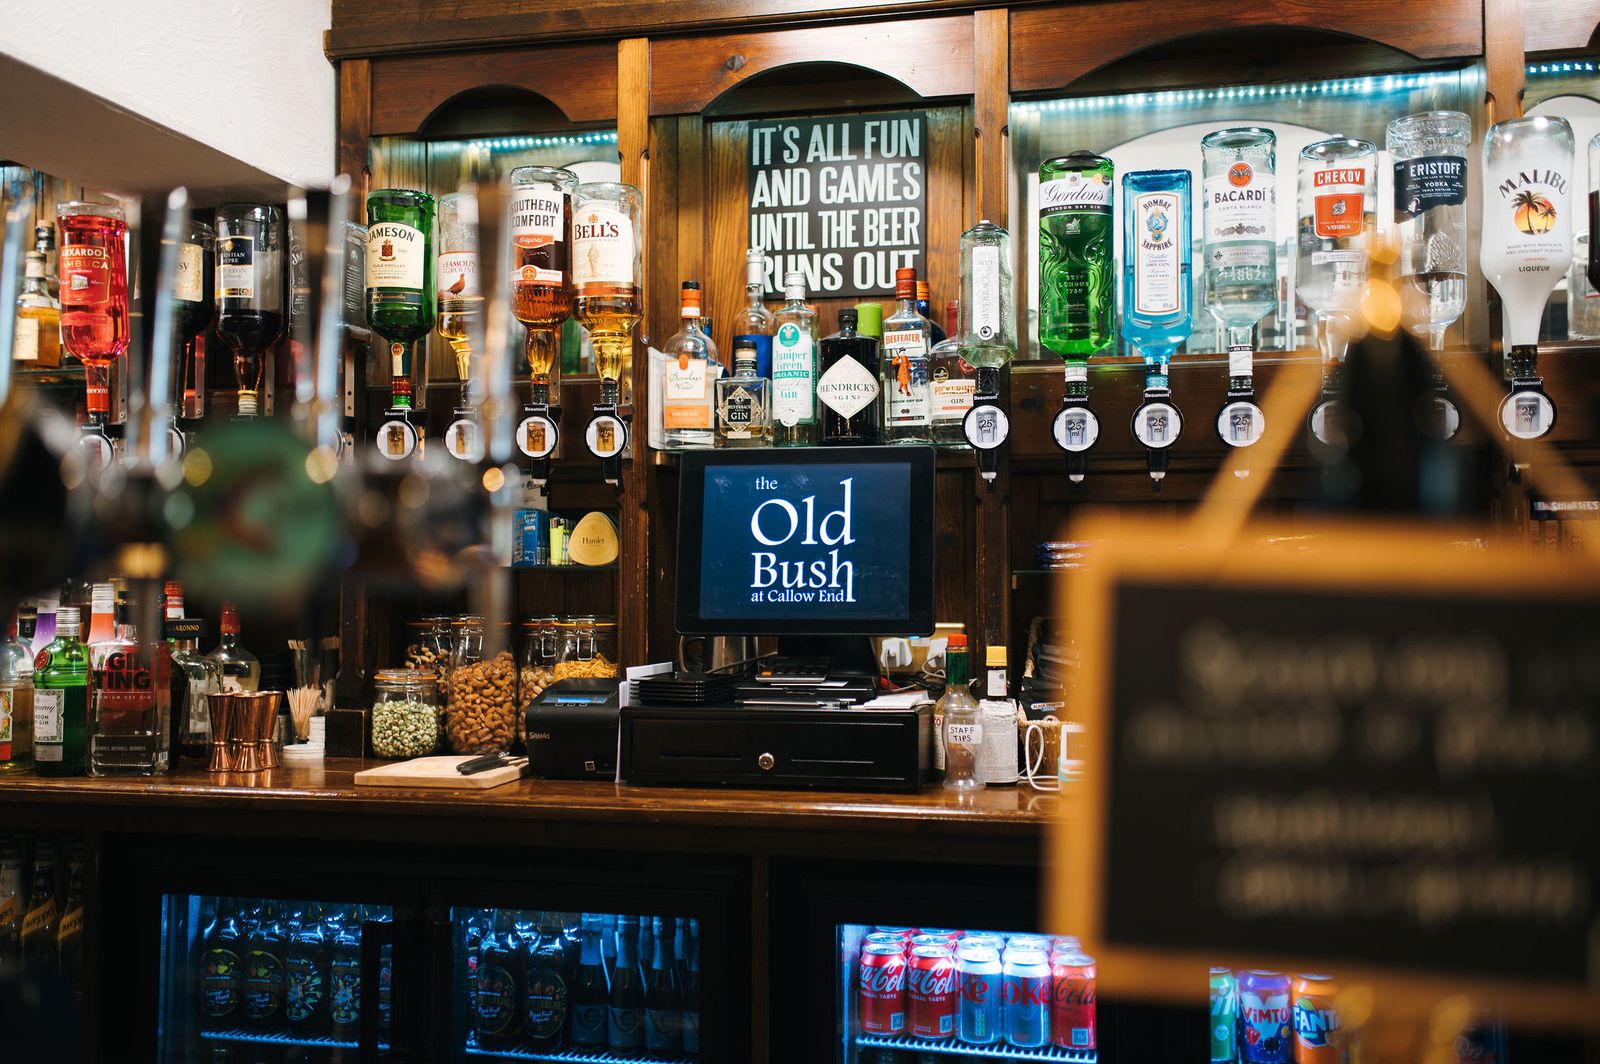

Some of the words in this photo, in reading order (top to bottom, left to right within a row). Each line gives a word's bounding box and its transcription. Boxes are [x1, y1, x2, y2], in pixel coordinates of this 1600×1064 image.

[752, 124, 800, 165] IT'S
[806, 123, 857, 162] ALL
[864, 118, 920, 159] FUN
[1410, 162, 1461, 177] ERISTOFF
[1317, 170, 1361, 184] CHEKOV
[1498, 169, 1569, 198] MALIBU
[751, 167, 811, 208] AND
[819, 162, 920, 204] GAMES
[1044, 183, 1105, 203] Gordon's
[1214, 187, 1266, 204] BACARDÍ
[1142, 199, 1172, 212] BOMBAY
[512, 214, 556, 228] COMFORT
[368, 226, 416, 243] JAMESON
[574, 221, 620, 241] BELL'S
[751, 212, 815, 251] UNTIL
[818, 209, 859, 249] THE
[863, 206, 920, 247] BEER
[519, 236, 545, 245] Original
[1141, 237, 1173, 251] SAPPHIRE
[61, 248, 103, 257] LUXARDO
[63, 259, 109, 270] AMBUCA
[853, 250, 920, 290] OUT
[885, 333, 921, 345] BEEFEATER
[775, 349, 808, 363] Juniper
[776, 360, 803, 370] Green
[774, 371, 809, 379] ORGANIC
[780, 388, 798, 399] Gin
[820, 383, 876, 393] HENDRICK'S
[934, 384, 976, 395] PICKERING
[730, 412, 748, 420] GIN
[1152, 418, 1165, 427] 25
[1235, 416, 1248, 425] 25
[981, 419, 993, 428] 25
[1070, 422, 1082, 430] 25
[755, 476, 778, 490] the
[750, 477, 856, 546] Old
[750, 548, 857, 603] Bush
[751, 590, 764, 602] at
[767, 589, 815, 602] Callow
[818, 589, 844, 602] End
[108, 652, 149, 671] GI
[92, 671, 150, 689] TING
[950, 726, 975, 734] STAFF
[958, 978, 988, 1003] ke
[1003, 978, 1051, 1005] oke
[1292, 1007, 1339, 1032] FANT
